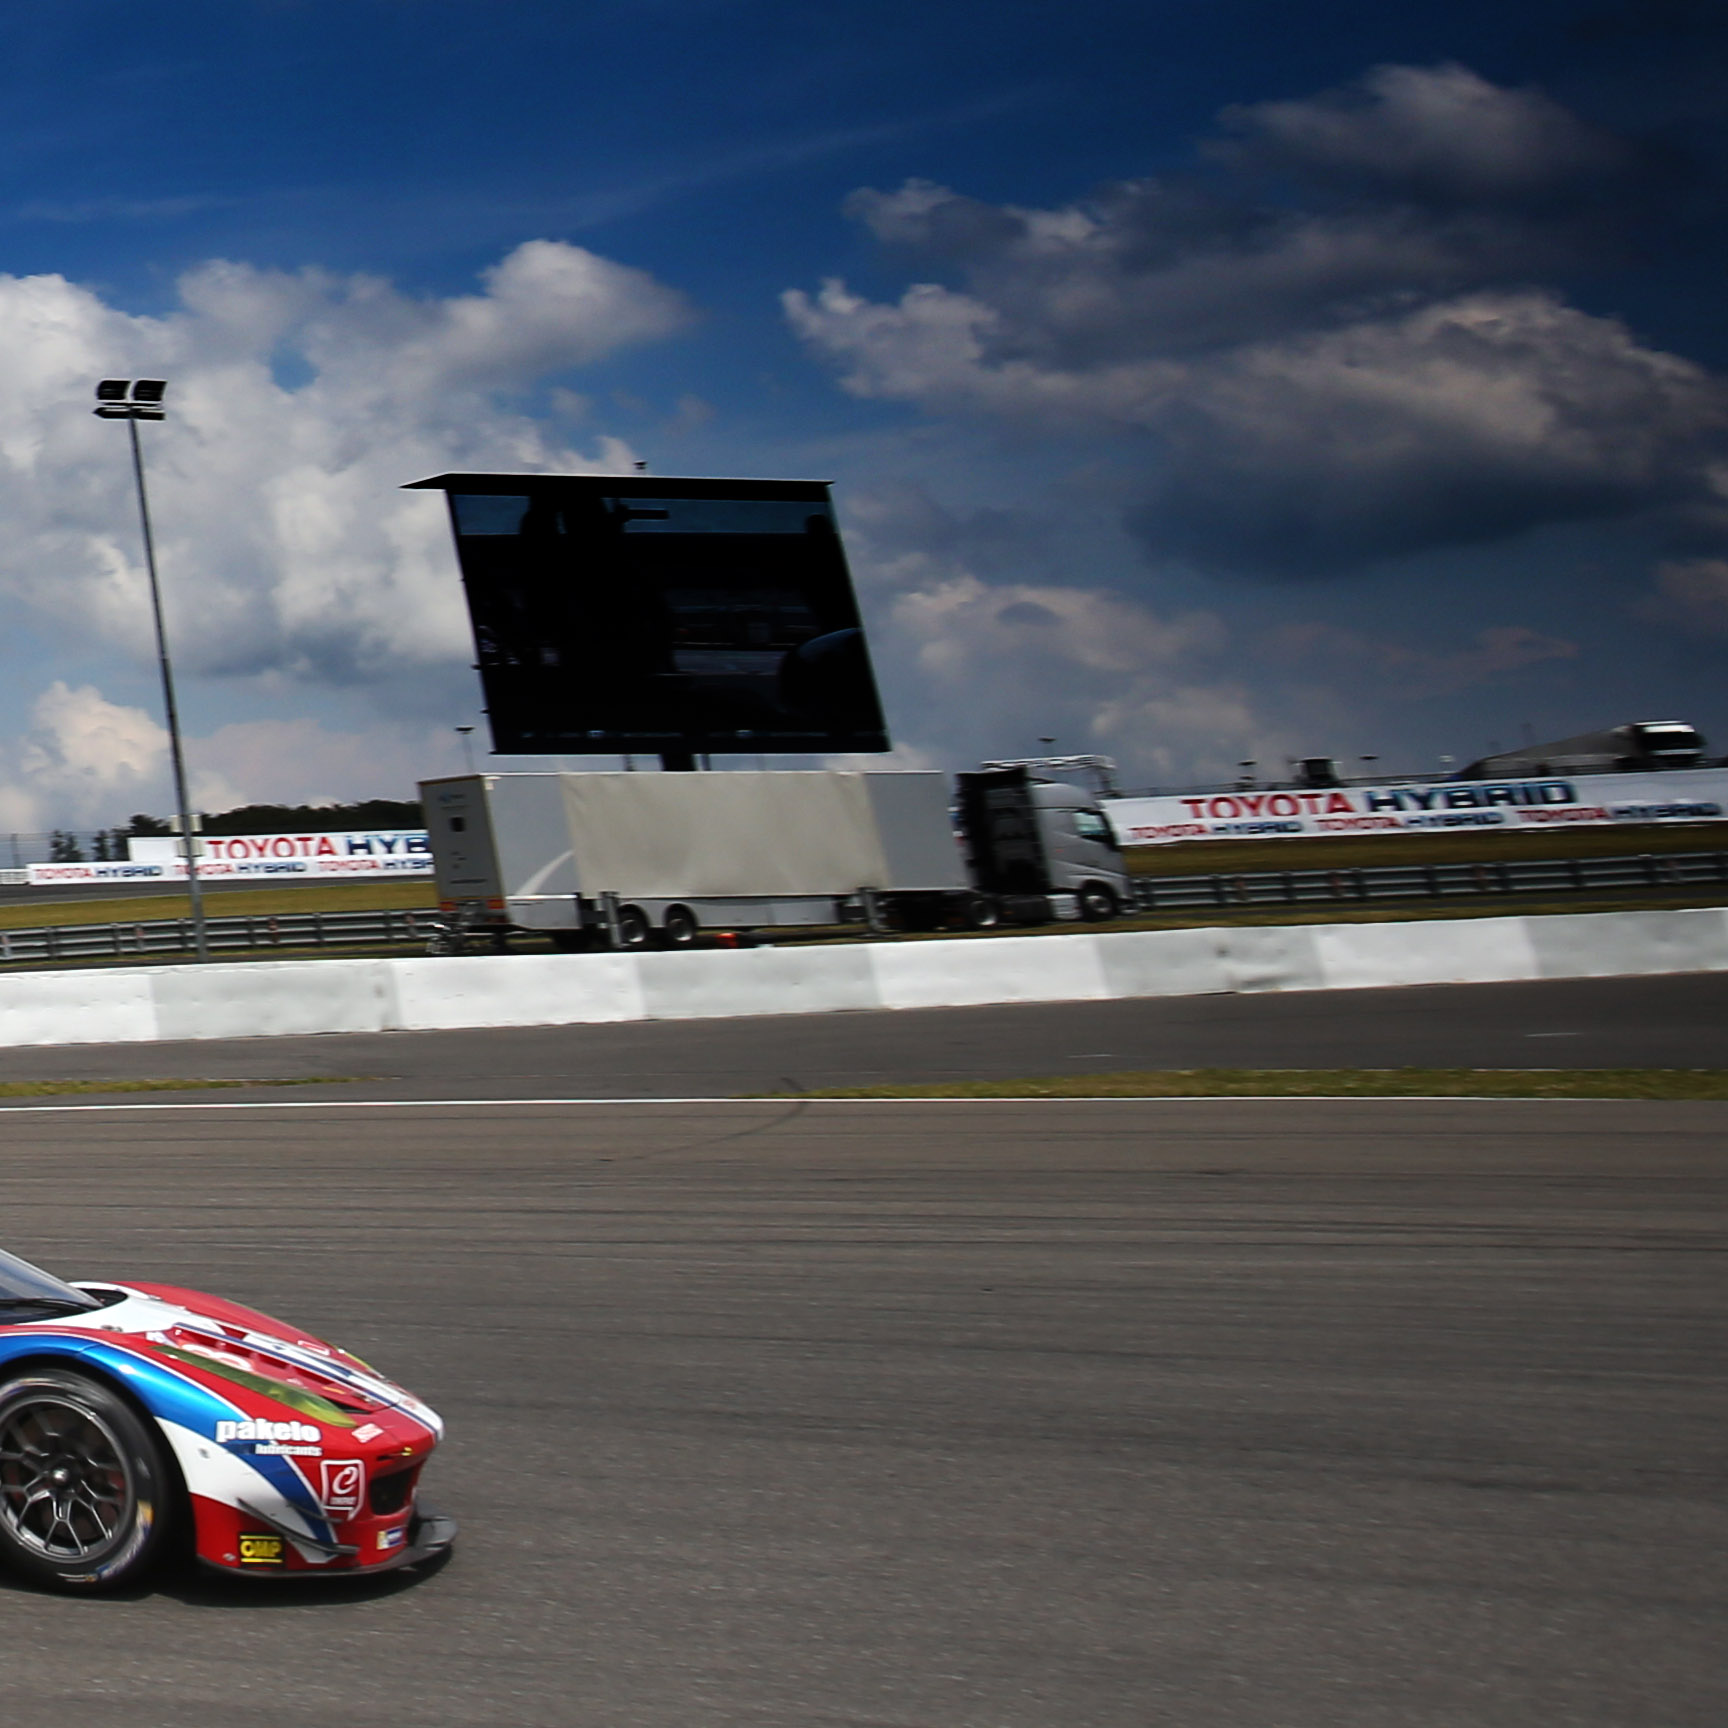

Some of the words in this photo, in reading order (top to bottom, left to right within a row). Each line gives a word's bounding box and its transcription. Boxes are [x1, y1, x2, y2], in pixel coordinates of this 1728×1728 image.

[1180, 792, 1355, 819] TOYOTA
[1364, 781, 1578, 812] HYBRID
[1315, 817, 1401, 831] TOYOTA
[1402, 812, 1505, 827] HYBRID
[1515, 806, 1610, 823] TOYOTA
[1612, 802, 1722, 818] HYBRID
[1128, 824, 1209, 840] TOYOTA
[1211, 821, 1304, 835] HYBRID
[205, 836, 337, 860] TOYOTA
[345, 833, 431, 855] HYB
[34, 867, 92, 880] TOYOTA
[94, 864, 163, 877] HYBRID
[236, 861, 308, 874] HYBRID
[317, 859, 382, 872] TOYOTA
[216, 1417, 323, 1443] pakelo
[240, 1539, 283, 1558] OMP
